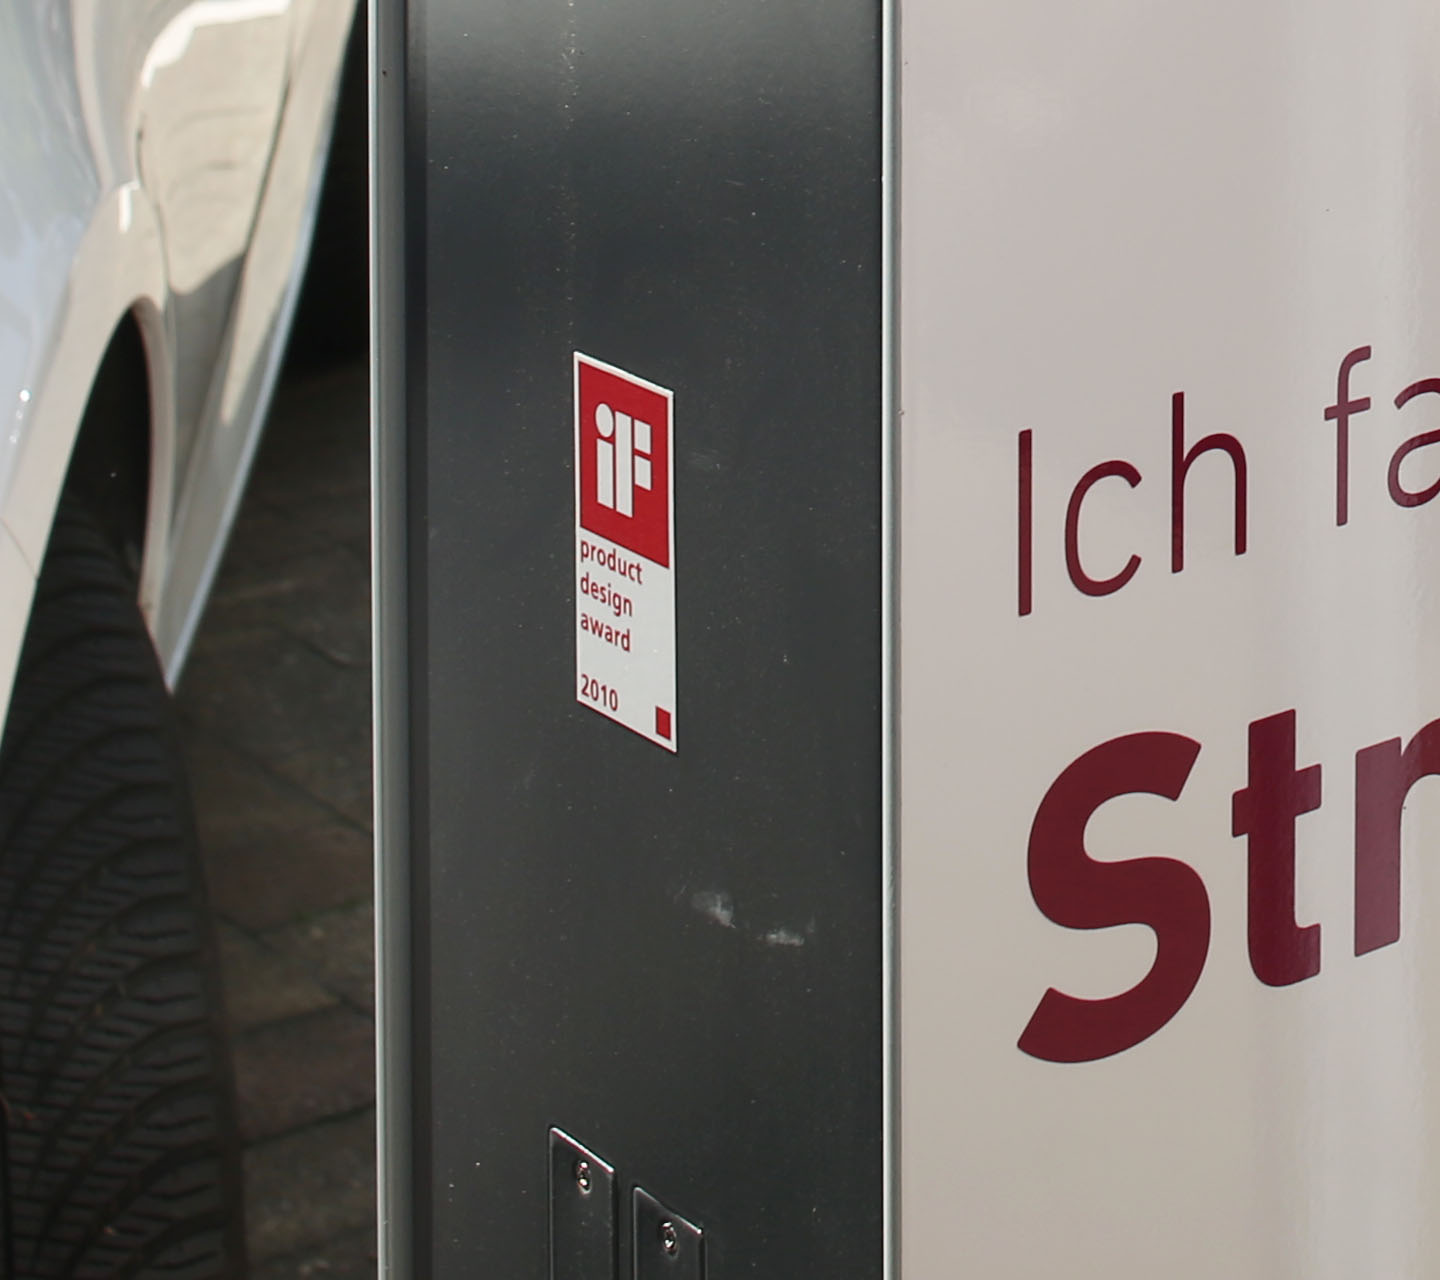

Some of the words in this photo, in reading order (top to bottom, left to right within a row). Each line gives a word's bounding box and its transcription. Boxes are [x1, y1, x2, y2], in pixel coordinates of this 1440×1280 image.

[1017, 391, 1249, 618] Ich
[580, 539, 644, 587] product
[580, 571, 634, 617] design
[580, 611, 632, 653] award
[580, 673, 619, 712] 2010
